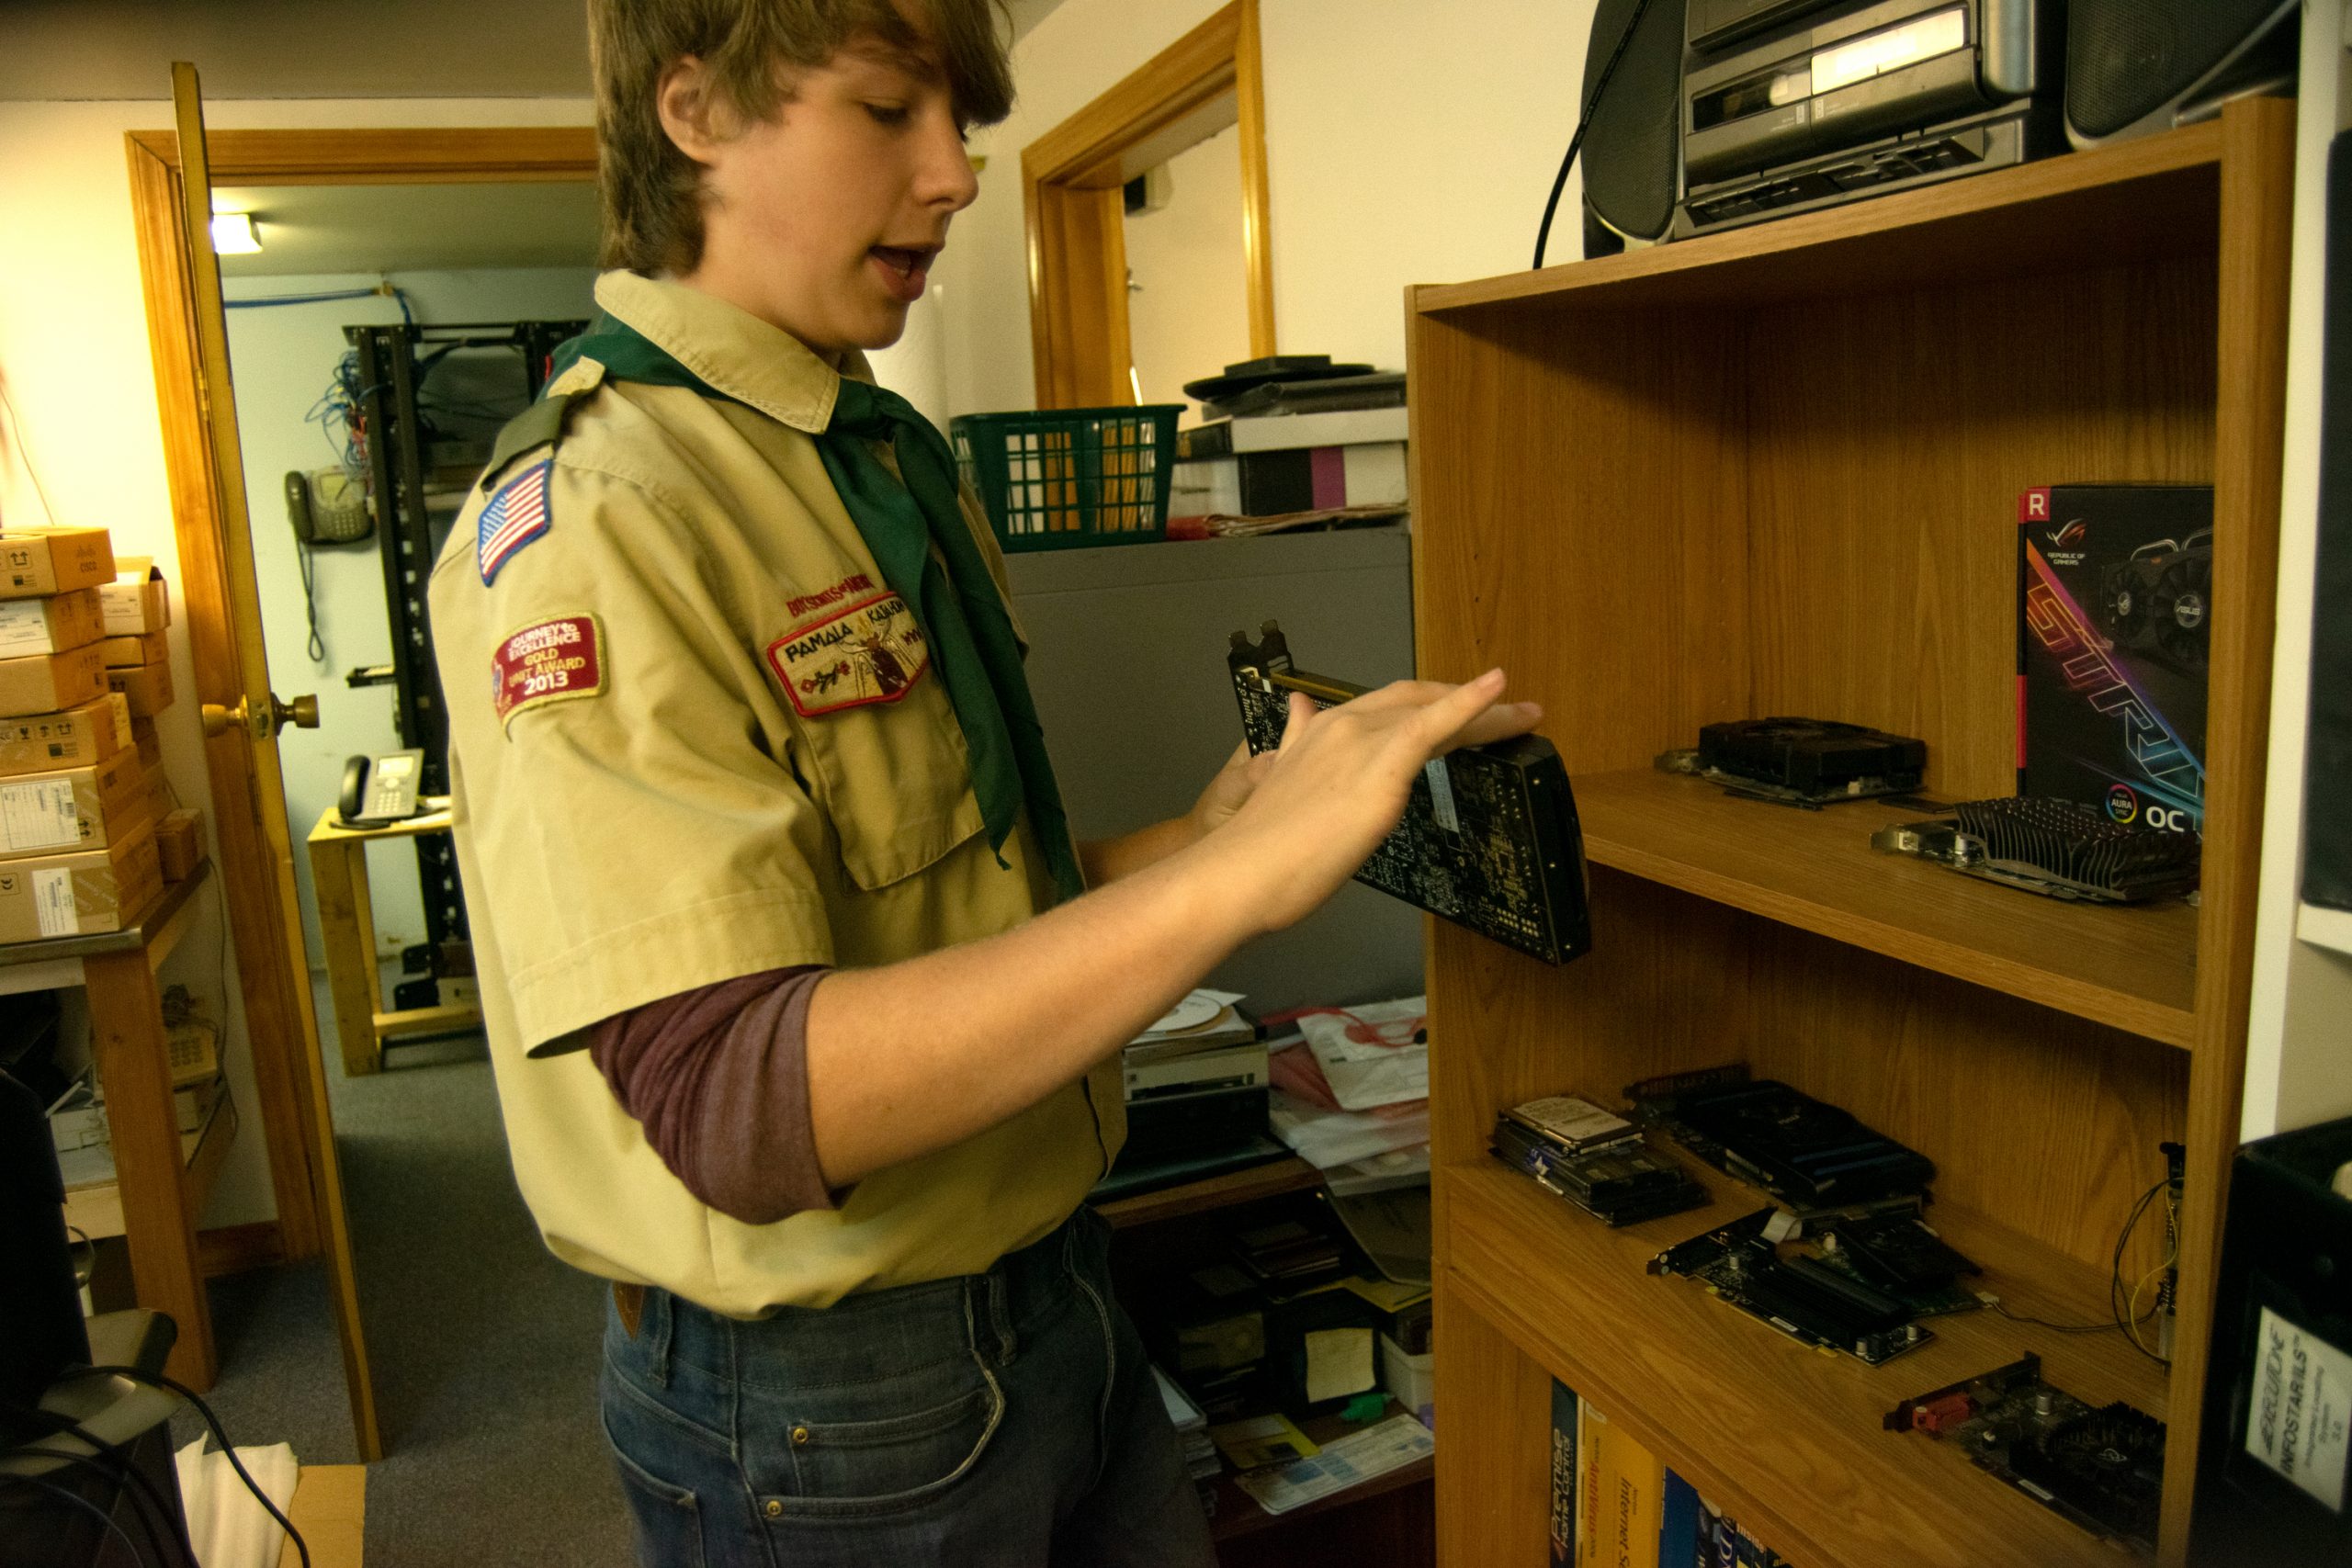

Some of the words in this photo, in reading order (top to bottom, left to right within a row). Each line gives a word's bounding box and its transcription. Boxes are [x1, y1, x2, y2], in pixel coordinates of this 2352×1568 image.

[2029, 493, 2044, 516] R
[508, 623, 560, 650] JOURNEY
[560, 622, 578, 634] to
[508, 631, 581, 661] EXCELLENCE
[508, 667, 534, 688] UNIT
[535, 656, 585, 675] AWARD
[524, 648, 559, 667] GOLD
[524, 671, 569, 696] 2013
[2110, 798, 2132, 810] AURA
[2145, 806, 2185, 832] OC
[1561, 1435, 1571, 1495] Control
[1551, 1427, 1563, 1542] Premise
[1560, 1498, 1569, 1549] Home
[1619, 1477, 1633, 1551] Internet
